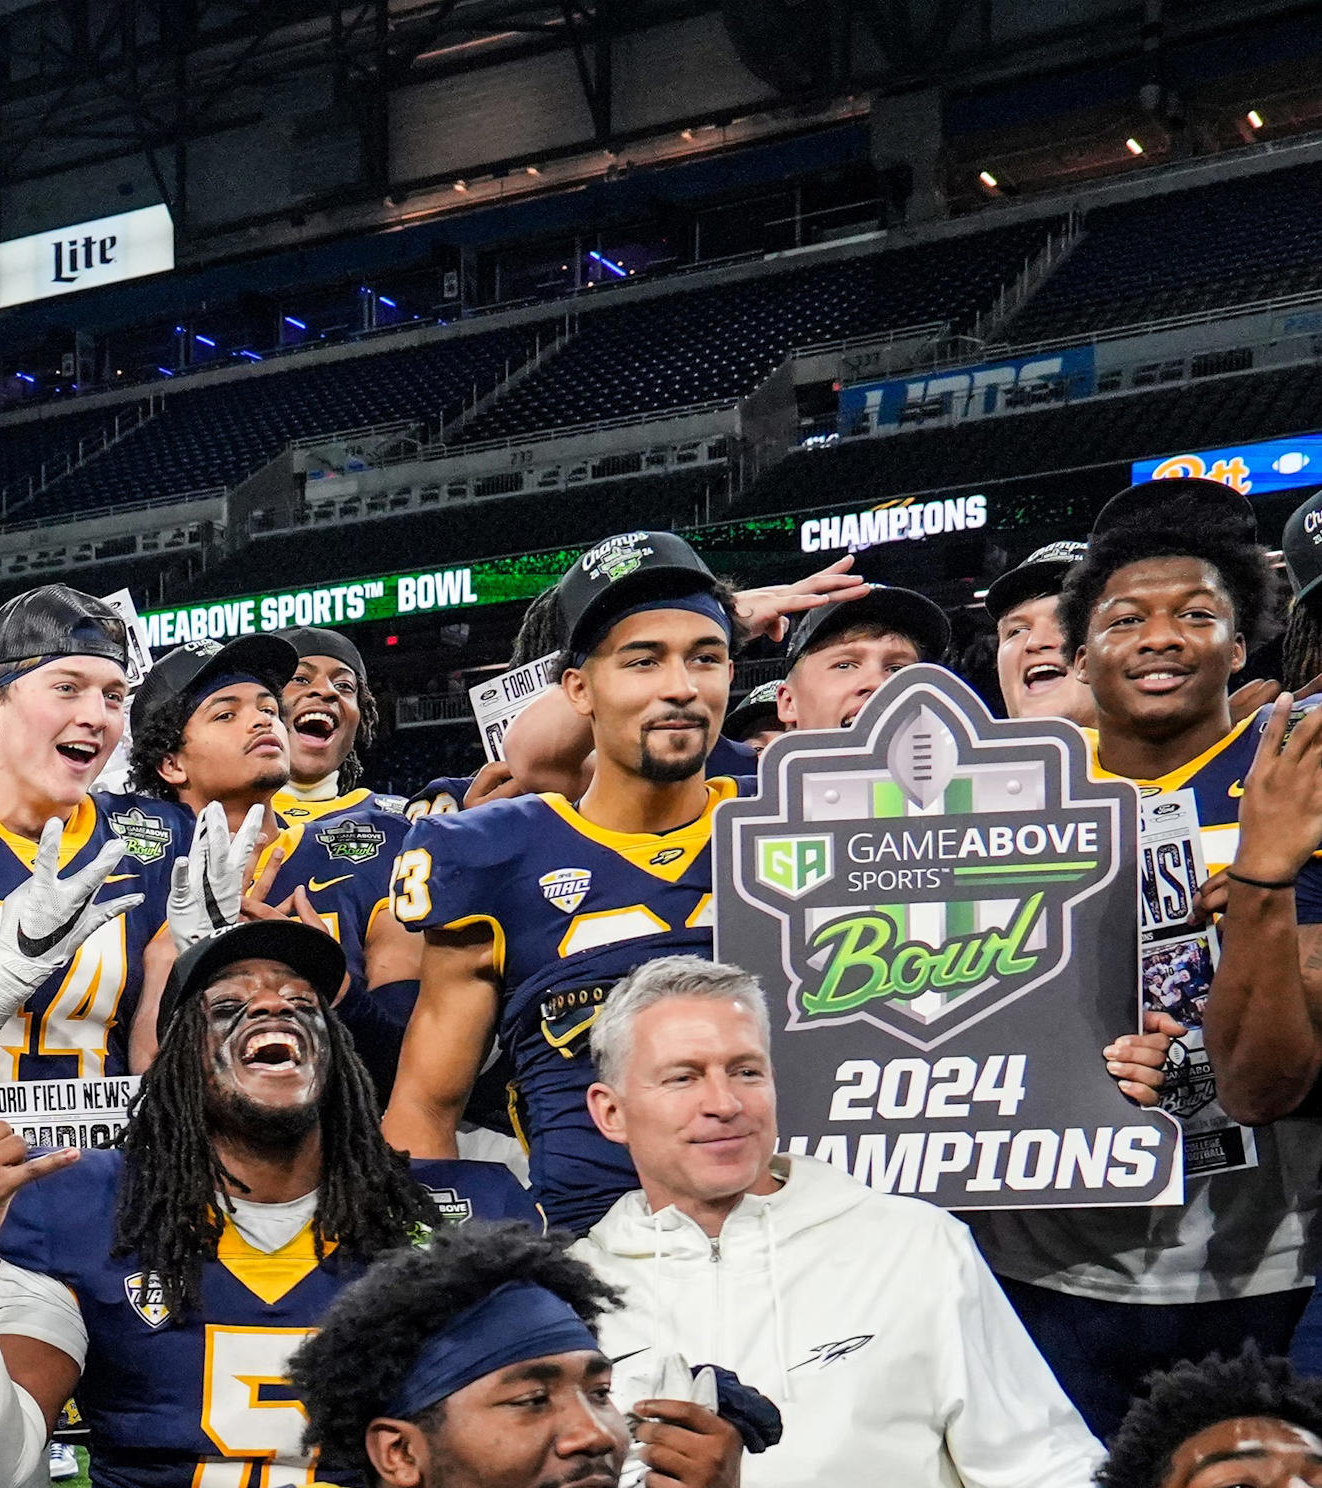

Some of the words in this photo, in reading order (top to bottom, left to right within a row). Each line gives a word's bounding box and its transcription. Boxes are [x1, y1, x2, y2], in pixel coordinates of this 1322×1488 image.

[49, 233, 117, 283] Lite
[1152, 454, 1252, 496] Ptt
[801, 495, 988, 555] CHAMPIONS
[138, 595, 258, 648] MEABOVE
[397, 569, 478, 615] BOWL
[502, 665, 535, 702] FORD
[127, 839, 163, 857] Bowl
[335, 842, 375, 856] Bowl
[846, 822, 1099, 864] GAMEABOVE
[543, 879, 591, 899] MAC
[801, 890, 1045, 1018] Bowl
[33, 1083, 76, 1111] FIELD
[83, 1081, 130, 1109] NEWS
[828, 1054, 1028, 1122] 2024
[776, 1125, 1162, 1194] AMPIONS
